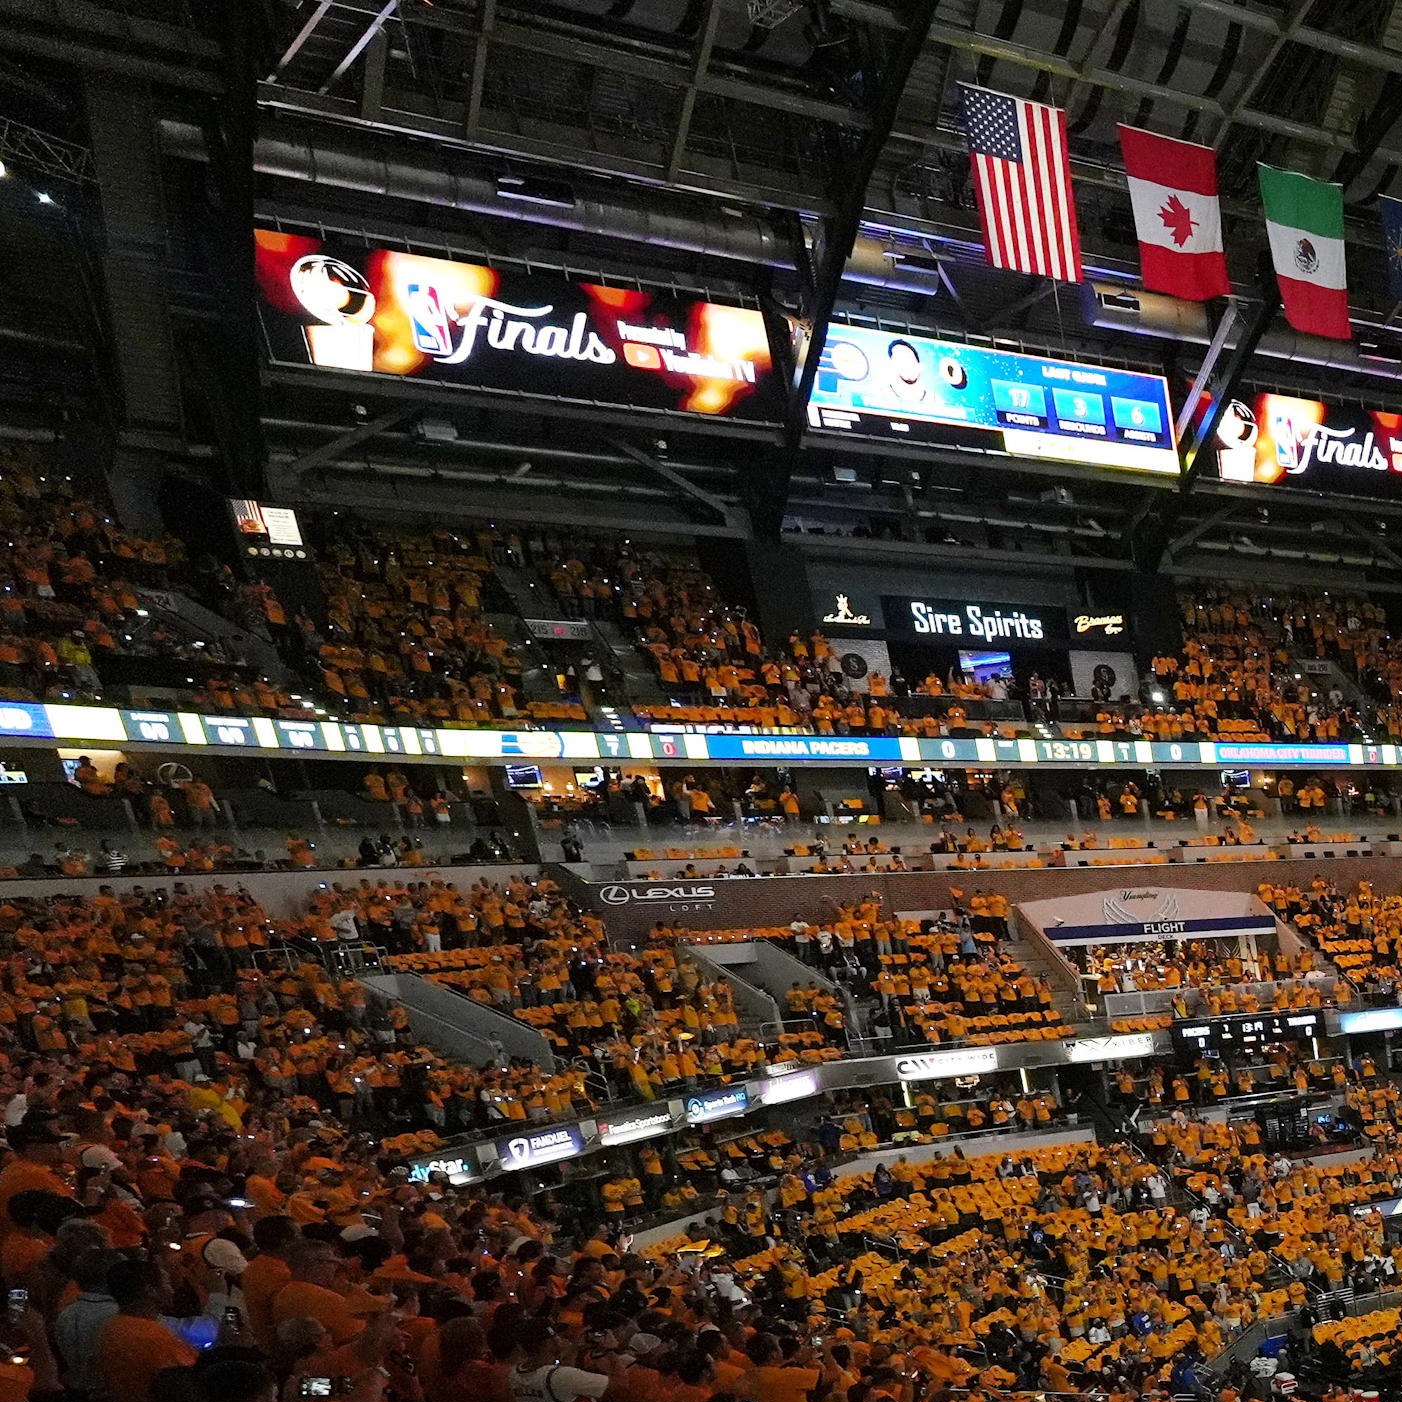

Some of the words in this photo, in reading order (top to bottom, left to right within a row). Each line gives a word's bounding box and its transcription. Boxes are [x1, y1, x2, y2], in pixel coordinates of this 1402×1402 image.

[433, 293, 617, 365] Finals
[1286, 420, 1389, 475] Finals
[911, 601, 963, 635] Sire
[966, 605, 1043, 642] Spirits
[742, 740, 809, 754] INDIANA
[809, 740, 870, 755] PACERS
[941, 740, 956, 759] 0
[1042, 742, 1093, 759] 13:19
[1169, 743, 1182, 760] 0
[631, 886, 716, 900] LEXUS
[669, 904, 714, 912] LOFT
[1144, 922, 1186, 934] FLIGHT
[530, 1130, 572, 1150] FANDUEL
[408, 1158, 470, 1183] dyStar.
